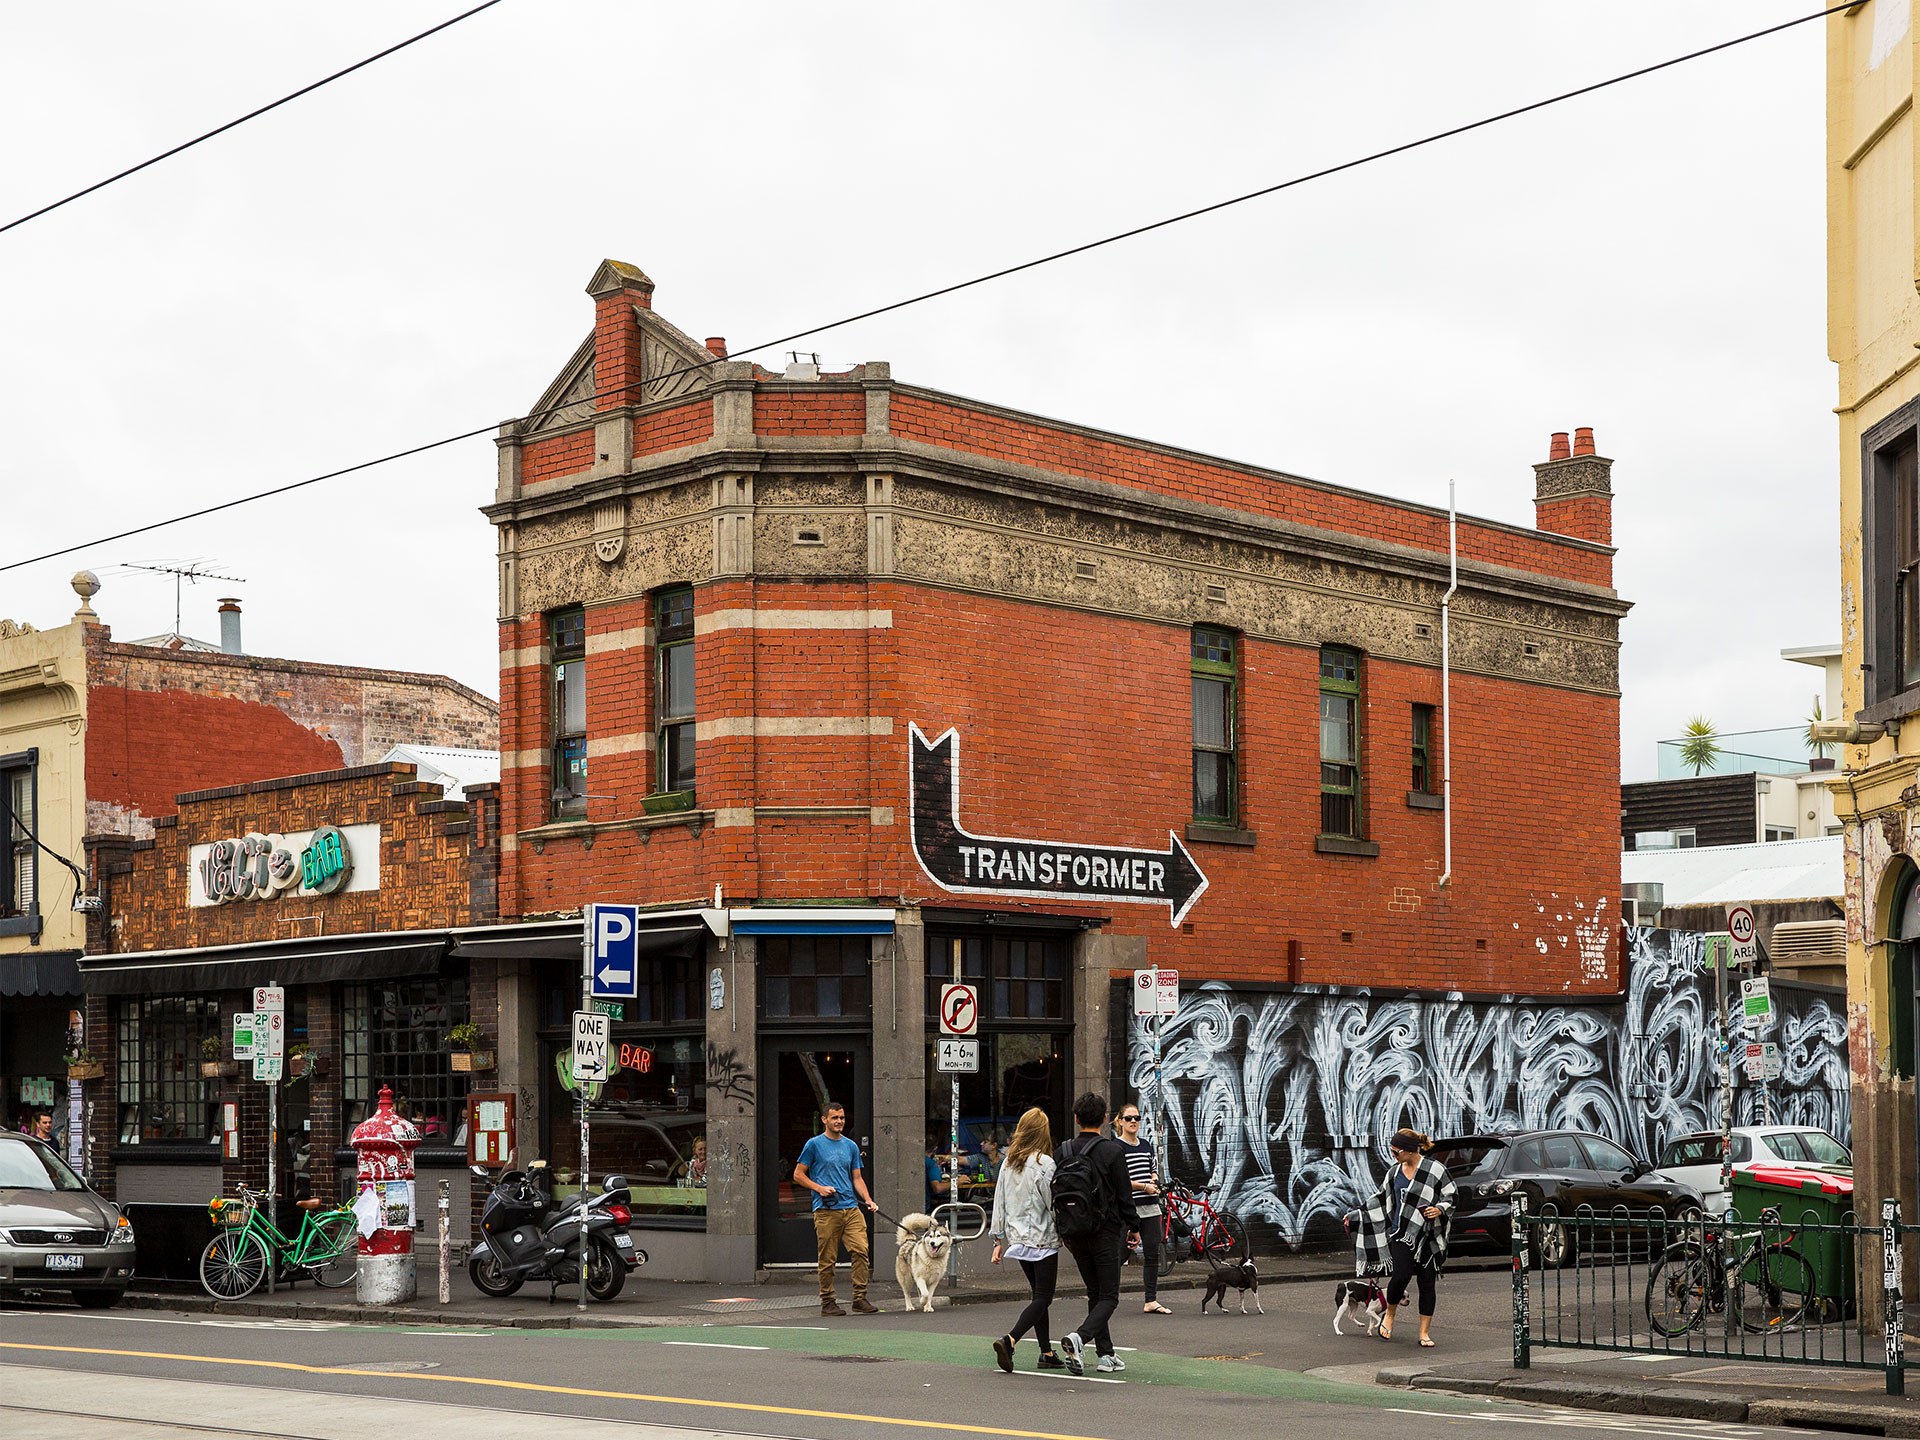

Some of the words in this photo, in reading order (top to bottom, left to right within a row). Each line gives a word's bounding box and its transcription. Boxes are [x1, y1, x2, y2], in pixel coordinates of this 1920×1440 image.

[301, 832, 343, 889] BAR
[959, 846, 1165, 892] TRANSFORMER
[1734, 917, 1751, 932] 40
[598, 913, 632, 957] P
[1733, 946, 1757, 959] AREA
[594, 1002, 610, 1014] ROSE
[255, 1014, 268, 1025] 2P
[579, 1019, 603, 1035] ONE
[577, 1040, 604, 1055] WAY
[1765, 1046, 1774, 1054] 1P
[258, 1058, 265, 1069] P
[620, 1043, 651, 1074] BAR
